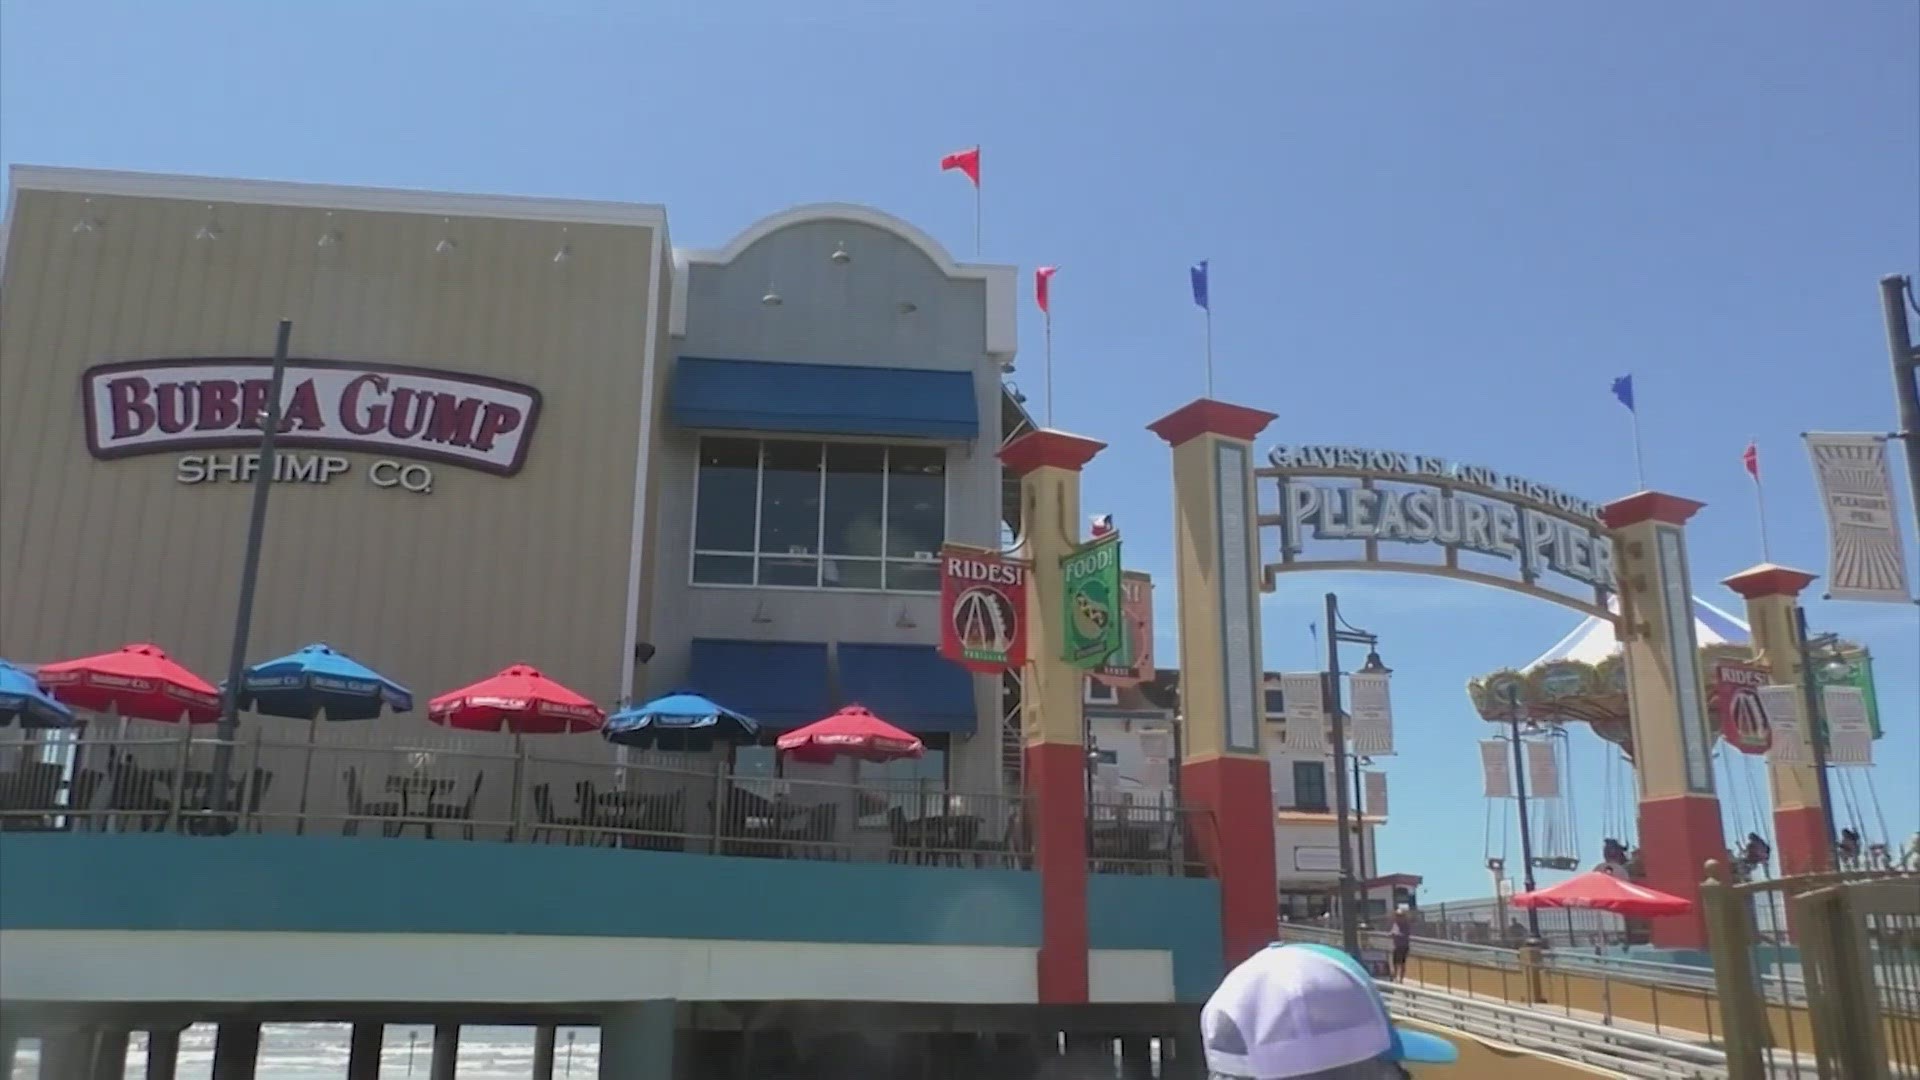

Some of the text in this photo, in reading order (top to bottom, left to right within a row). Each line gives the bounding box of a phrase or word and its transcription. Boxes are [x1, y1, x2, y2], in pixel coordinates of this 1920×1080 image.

[107, 373, 521, 452] BUBBA GUMP
[1268, 444, 1408, 472] GALVESTON
[1412, 454, 1500, 489] ISLAND
[1284, 479, 1618, 591] PLEASURE PIER
[947, 557, 1023, 585] RIDES!
[1066, 547, 1113, 583] FOOD!
